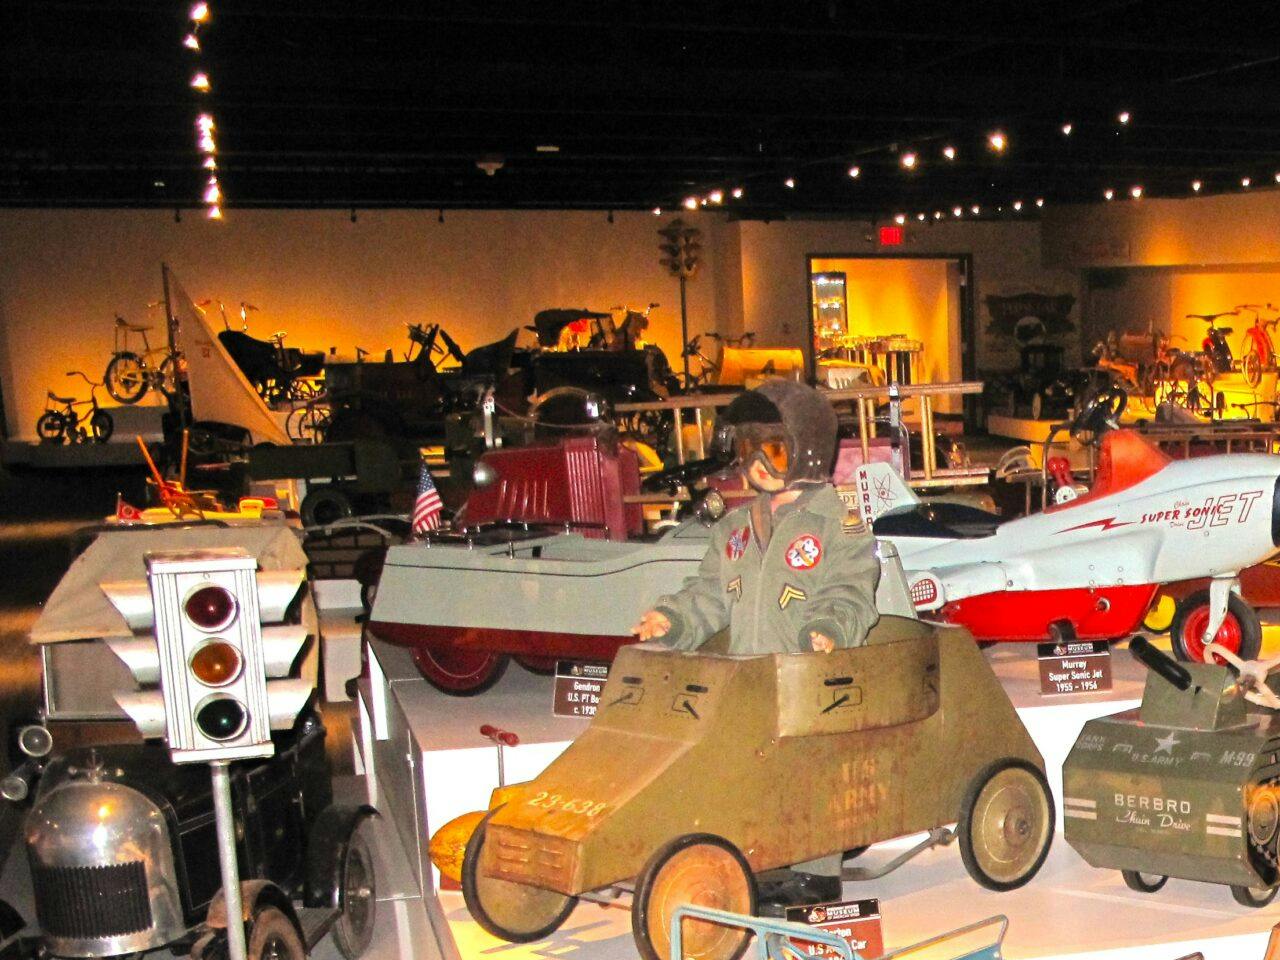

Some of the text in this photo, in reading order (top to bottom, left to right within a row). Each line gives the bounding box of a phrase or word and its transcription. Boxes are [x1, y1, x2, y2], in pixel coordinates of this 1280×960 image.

[1140, 504, 1223, 524] SUPER SONIC
[1187, 490, 1263, 530] JET
[1062, 660, 1087, 669] Murray
[1049, 670, 1103, 682] Super Sonic Jet
[574, 681, 600, 692] Gendron
[1057, 683, 1073, 692] 1955
[1081, 681, 1097, 690] 1956
[568, 693, 579, 702] U.S.
[582, 694, 590, 703] PT
[1114, 793, 1191, 814] BERBRO
[1157, 814, 1191, 830] Drive
[851, 939, 867, 950] Car
